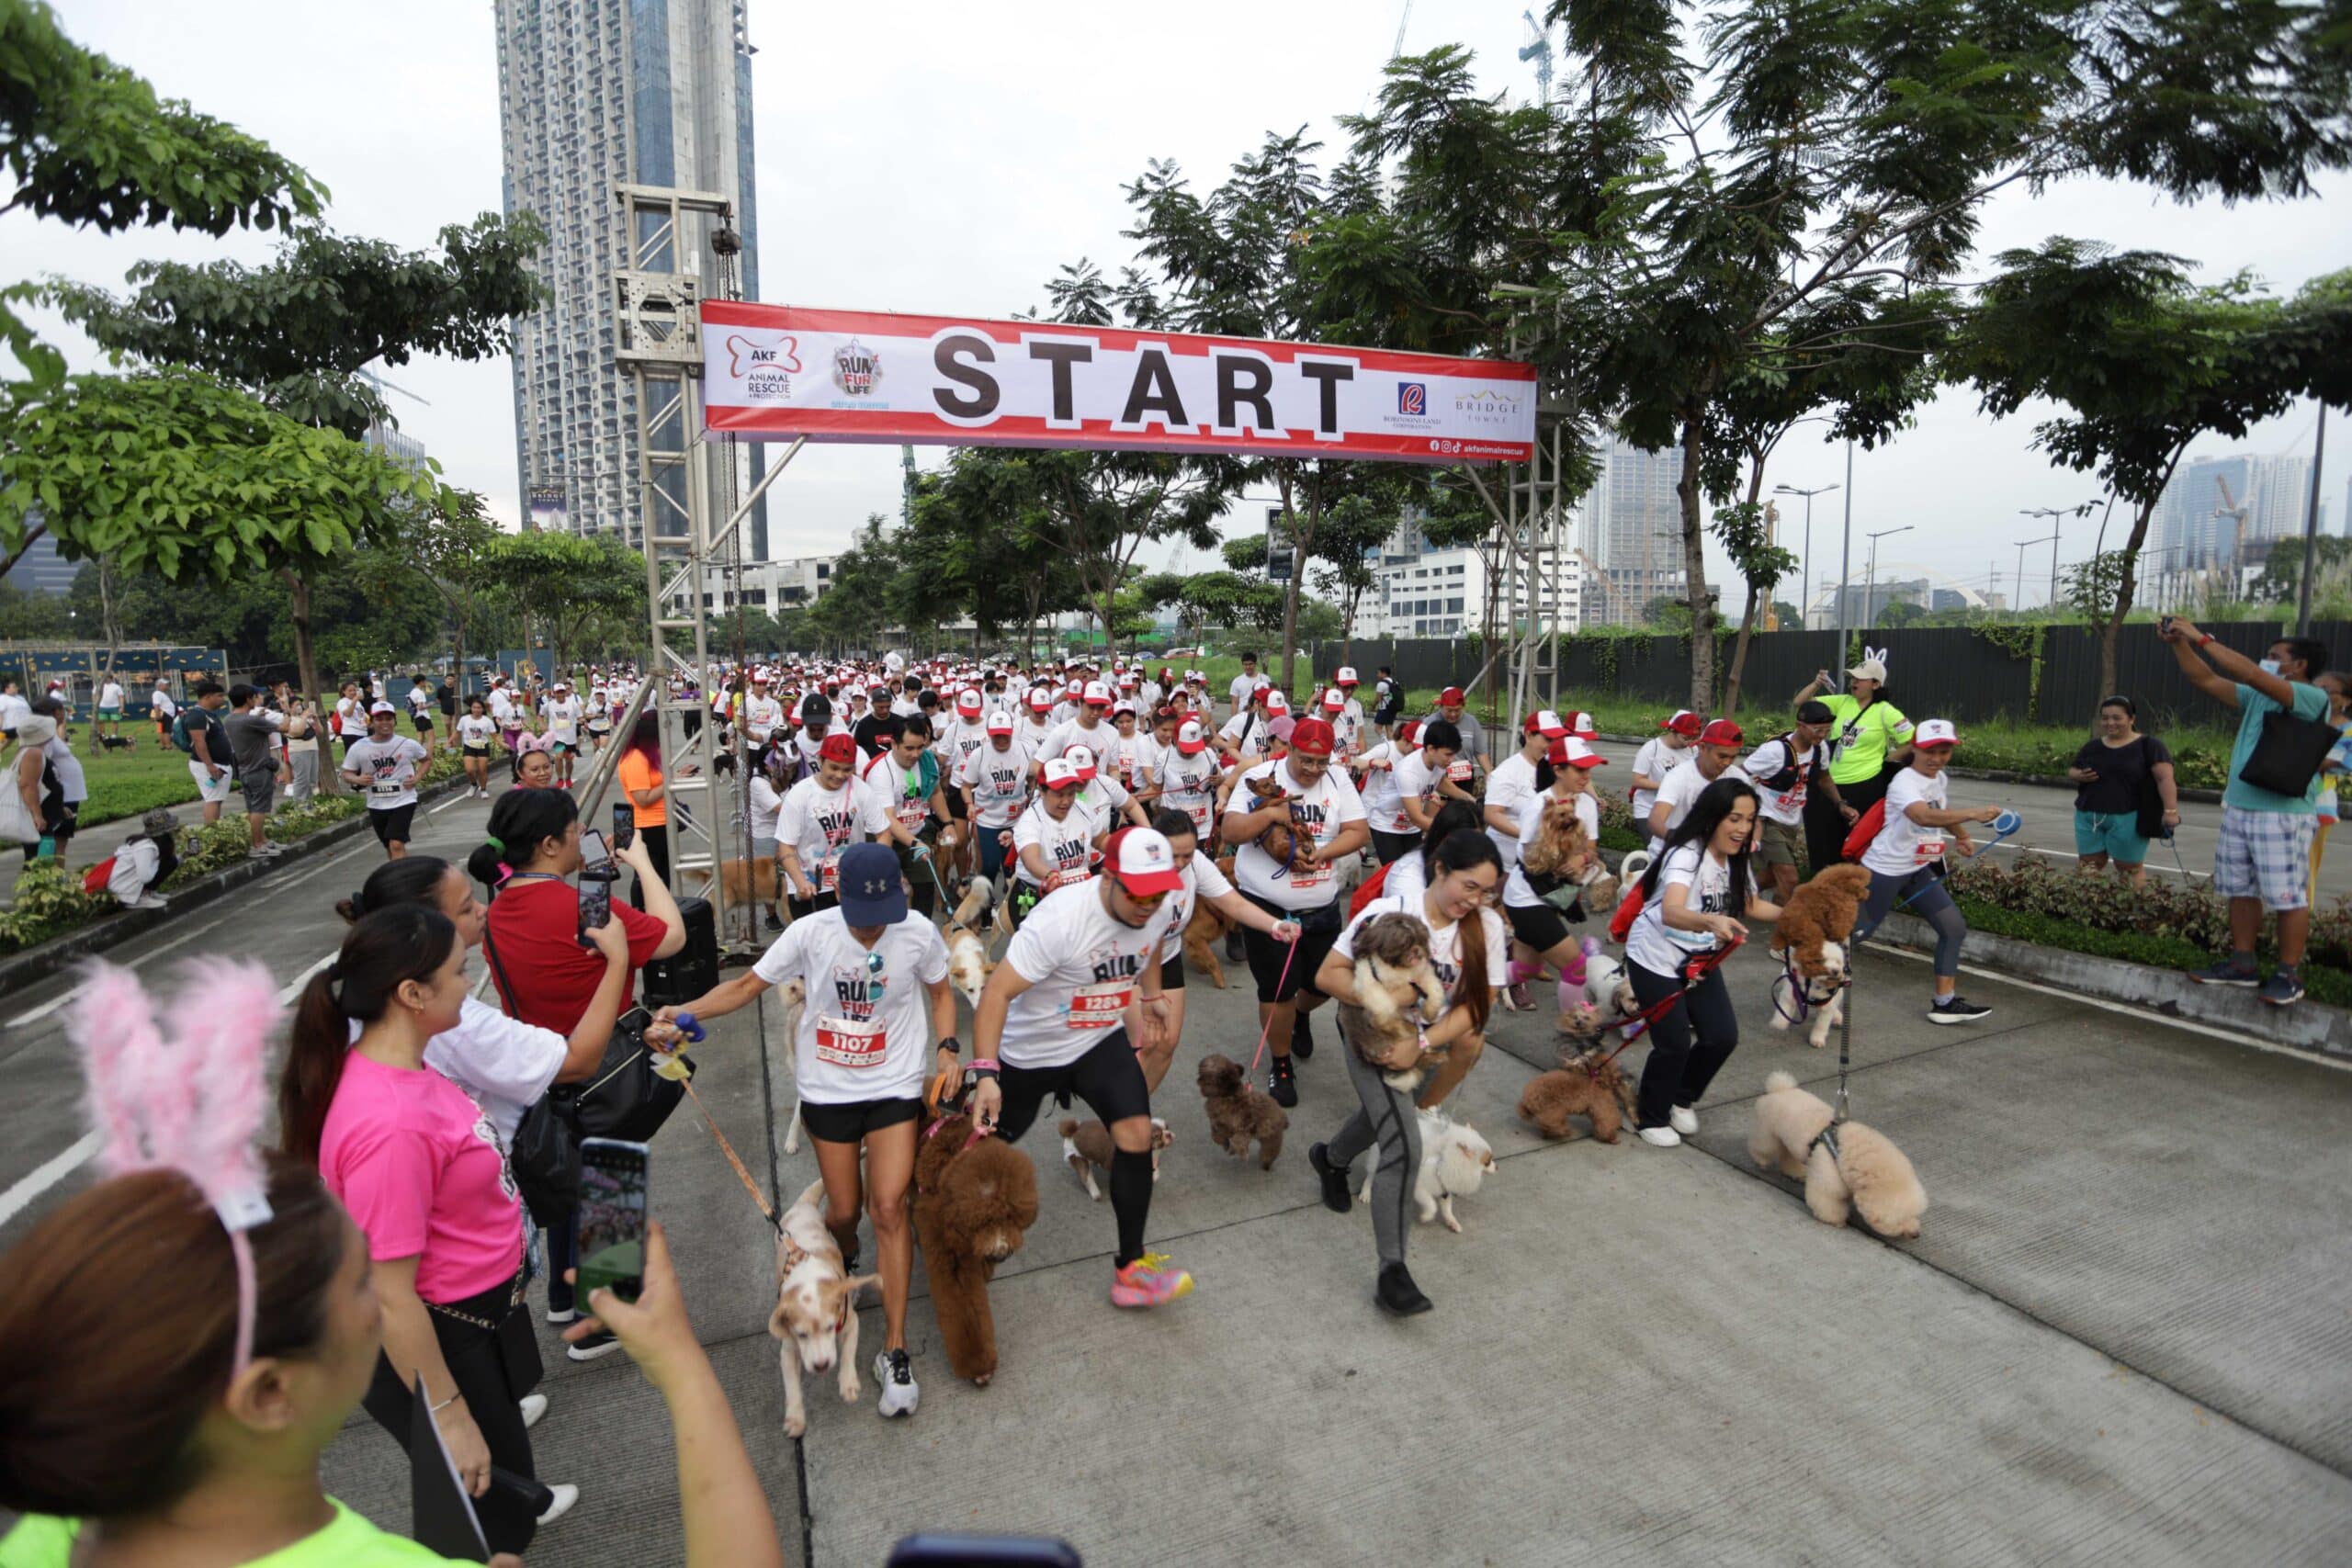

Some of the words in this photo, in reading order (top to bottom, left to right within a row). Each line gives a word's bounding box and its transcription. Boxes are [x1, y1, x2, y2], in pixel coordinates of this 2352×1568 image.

[752, 350, 776, 361] AKF
[838, 356, 874, 374] RUN
[749, 373, 790, 383] ANIMAL
[844, 374, 871, 385] FUR
[933, 334, 1353, 434] START
[749, 383, 791, 393] RESCUE
[845, 385, 869, 394] LIFE
[1455, 400, 1519, 413] BRIDGE
[1464, 445, 1524, 456] akfanimalrescue
[991, 770, 1016, 783] RUN
[1054, 839, 1085, 861] RUN
[1059, 855, 1085, 870] FUR
[840, 1000, 875, 1014] FUR
[831, 1032, 874, 1052] 1107
